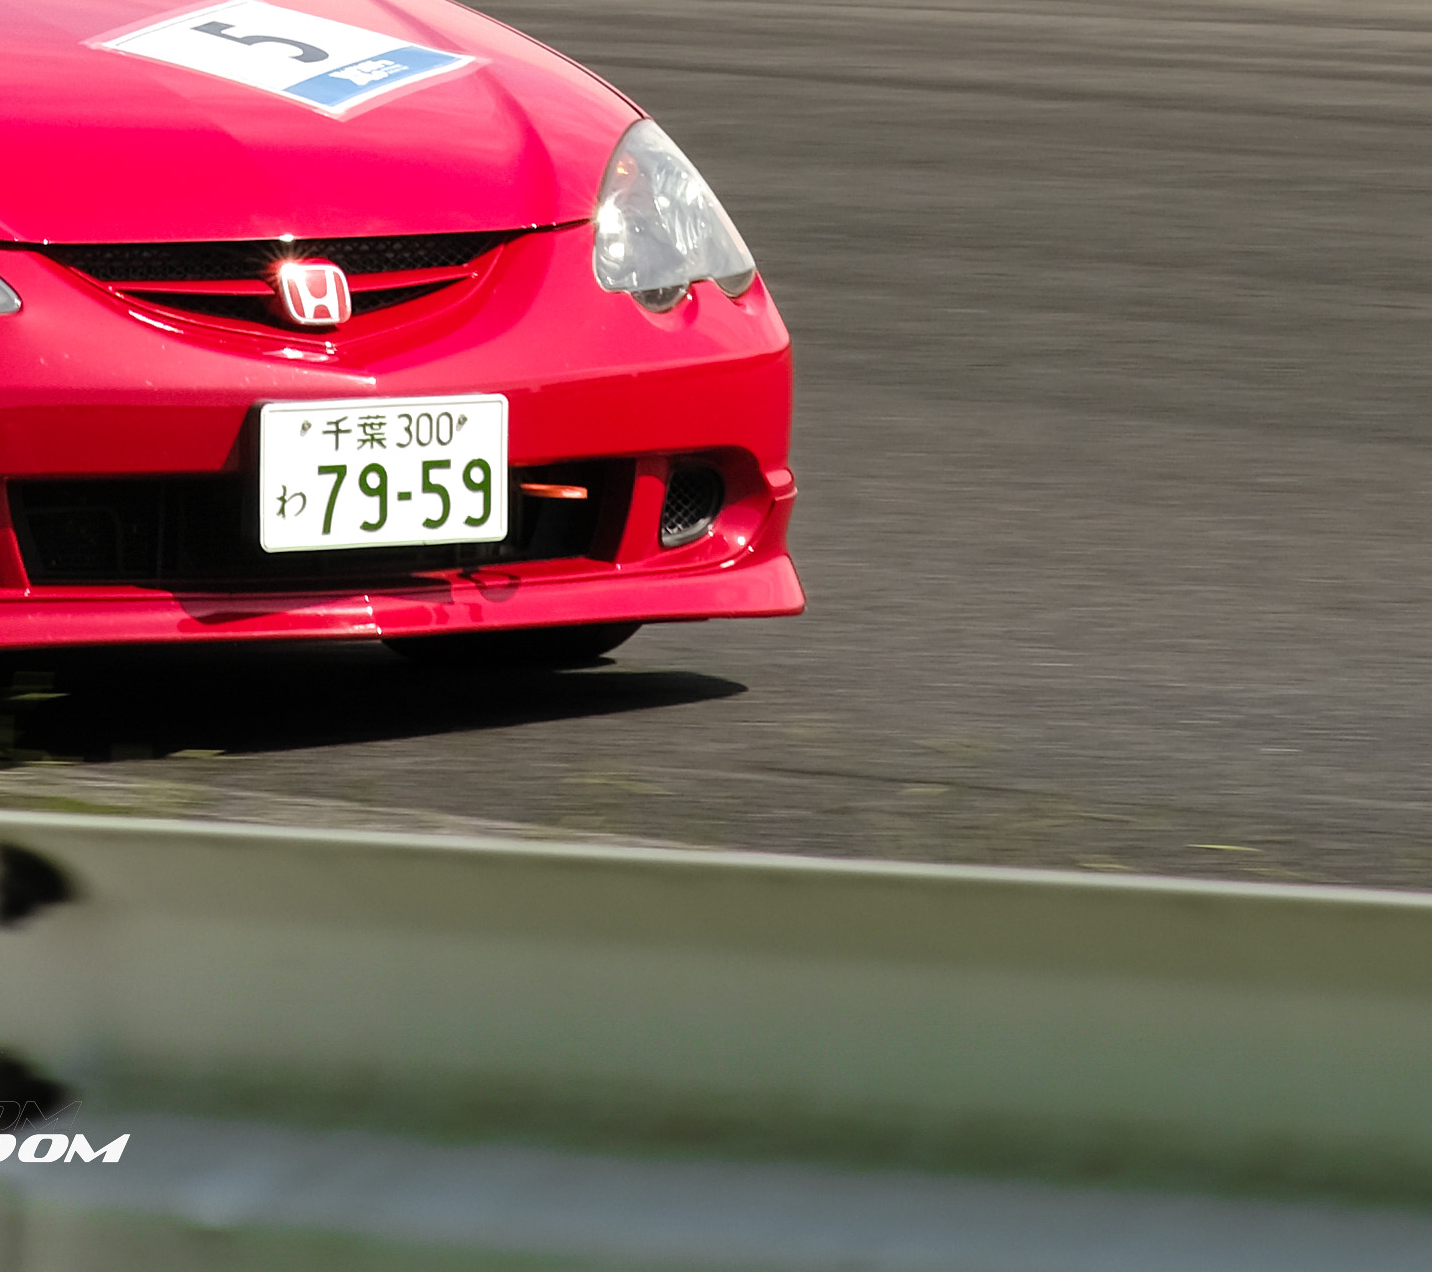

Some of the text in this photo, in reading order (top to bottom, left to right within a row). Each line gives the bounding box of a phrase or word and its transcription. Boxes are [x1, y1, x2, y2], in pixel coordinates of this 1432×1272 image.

[189, 20, 330, 64] 5
[321, 411, 454, 452] 千葉 300
[275, 458, 492, 536] わ 79-59
